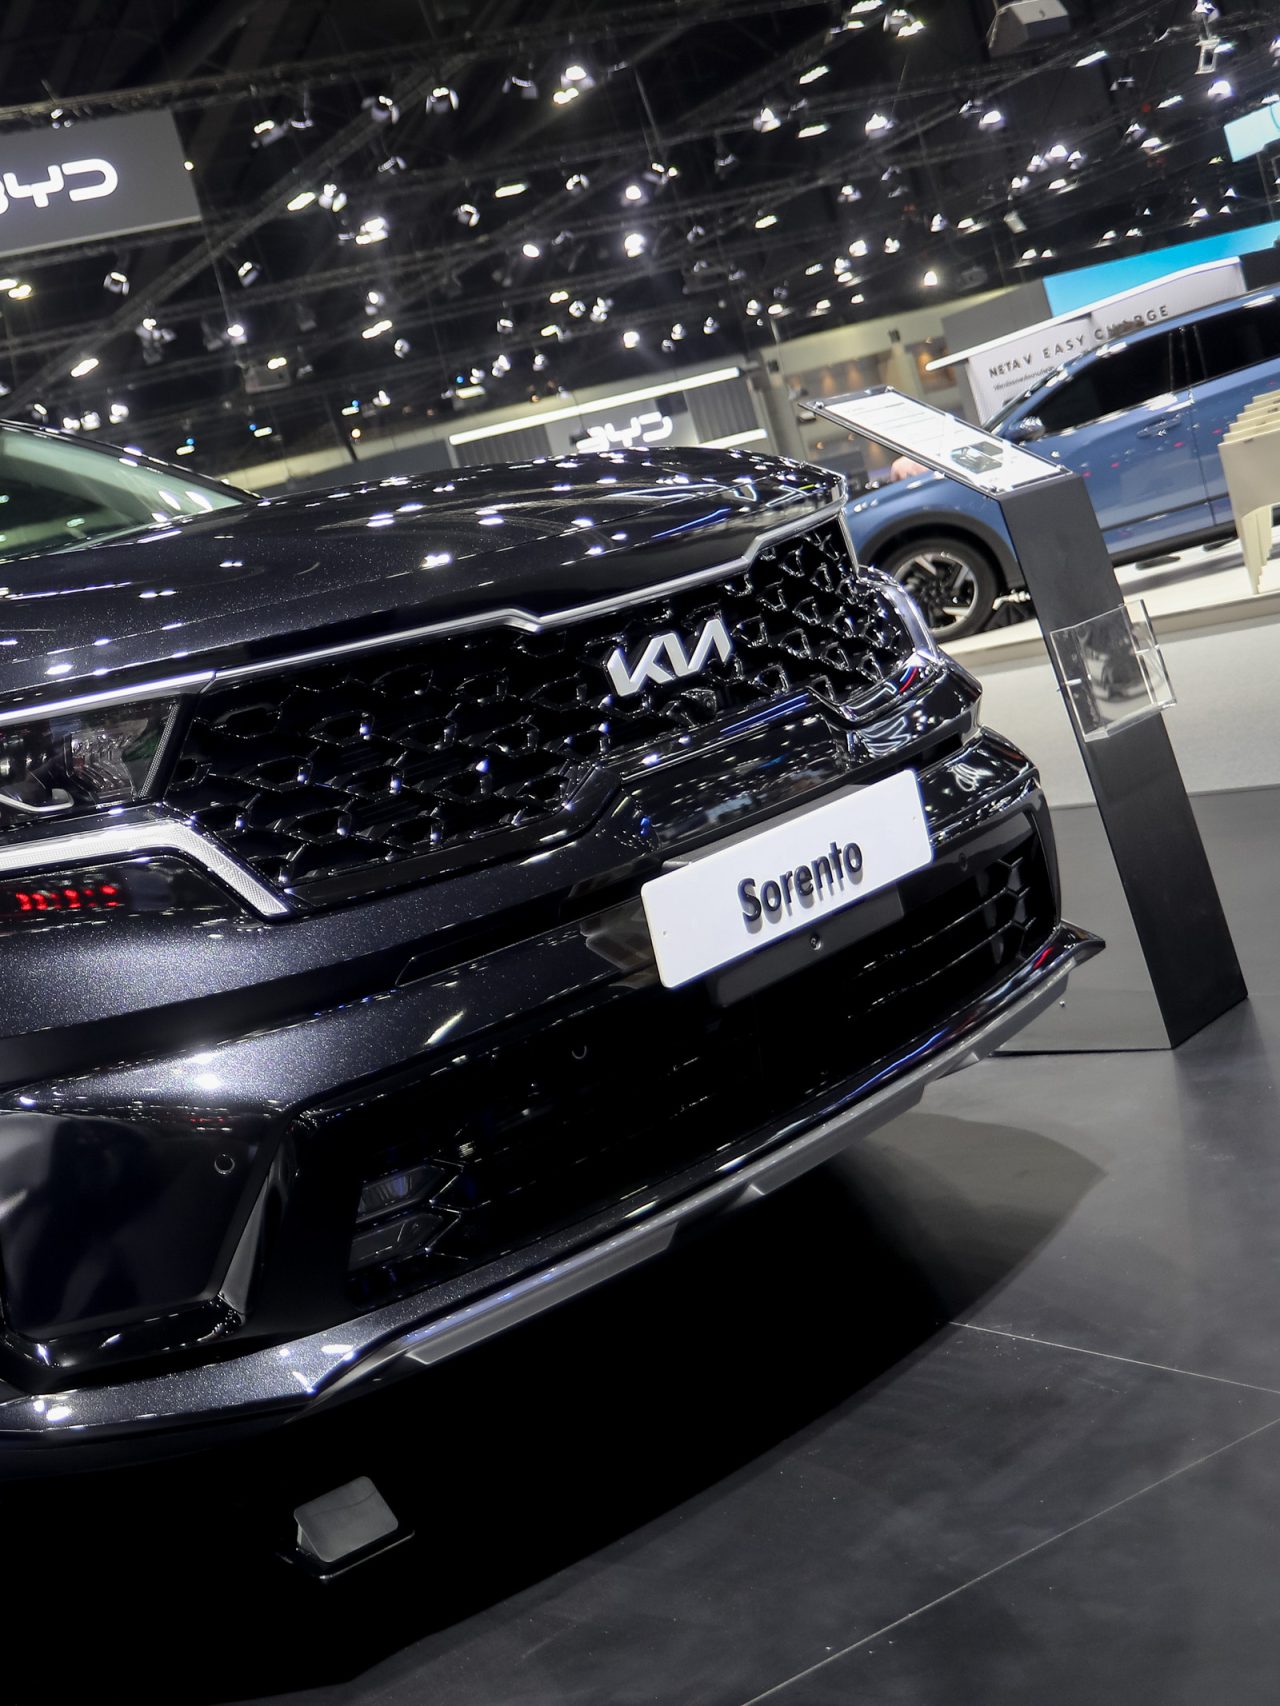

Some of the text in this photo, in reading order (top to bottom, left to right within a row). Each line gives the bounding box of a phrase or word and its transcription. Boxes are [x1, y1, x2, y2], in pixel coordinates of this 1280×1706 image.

[1042, 334, 1085, 360] EASY
[575, 411, 673, 453] BYD
[605, 617, 734, 698] KIA
[736, 840, 864, 924] Sorento
